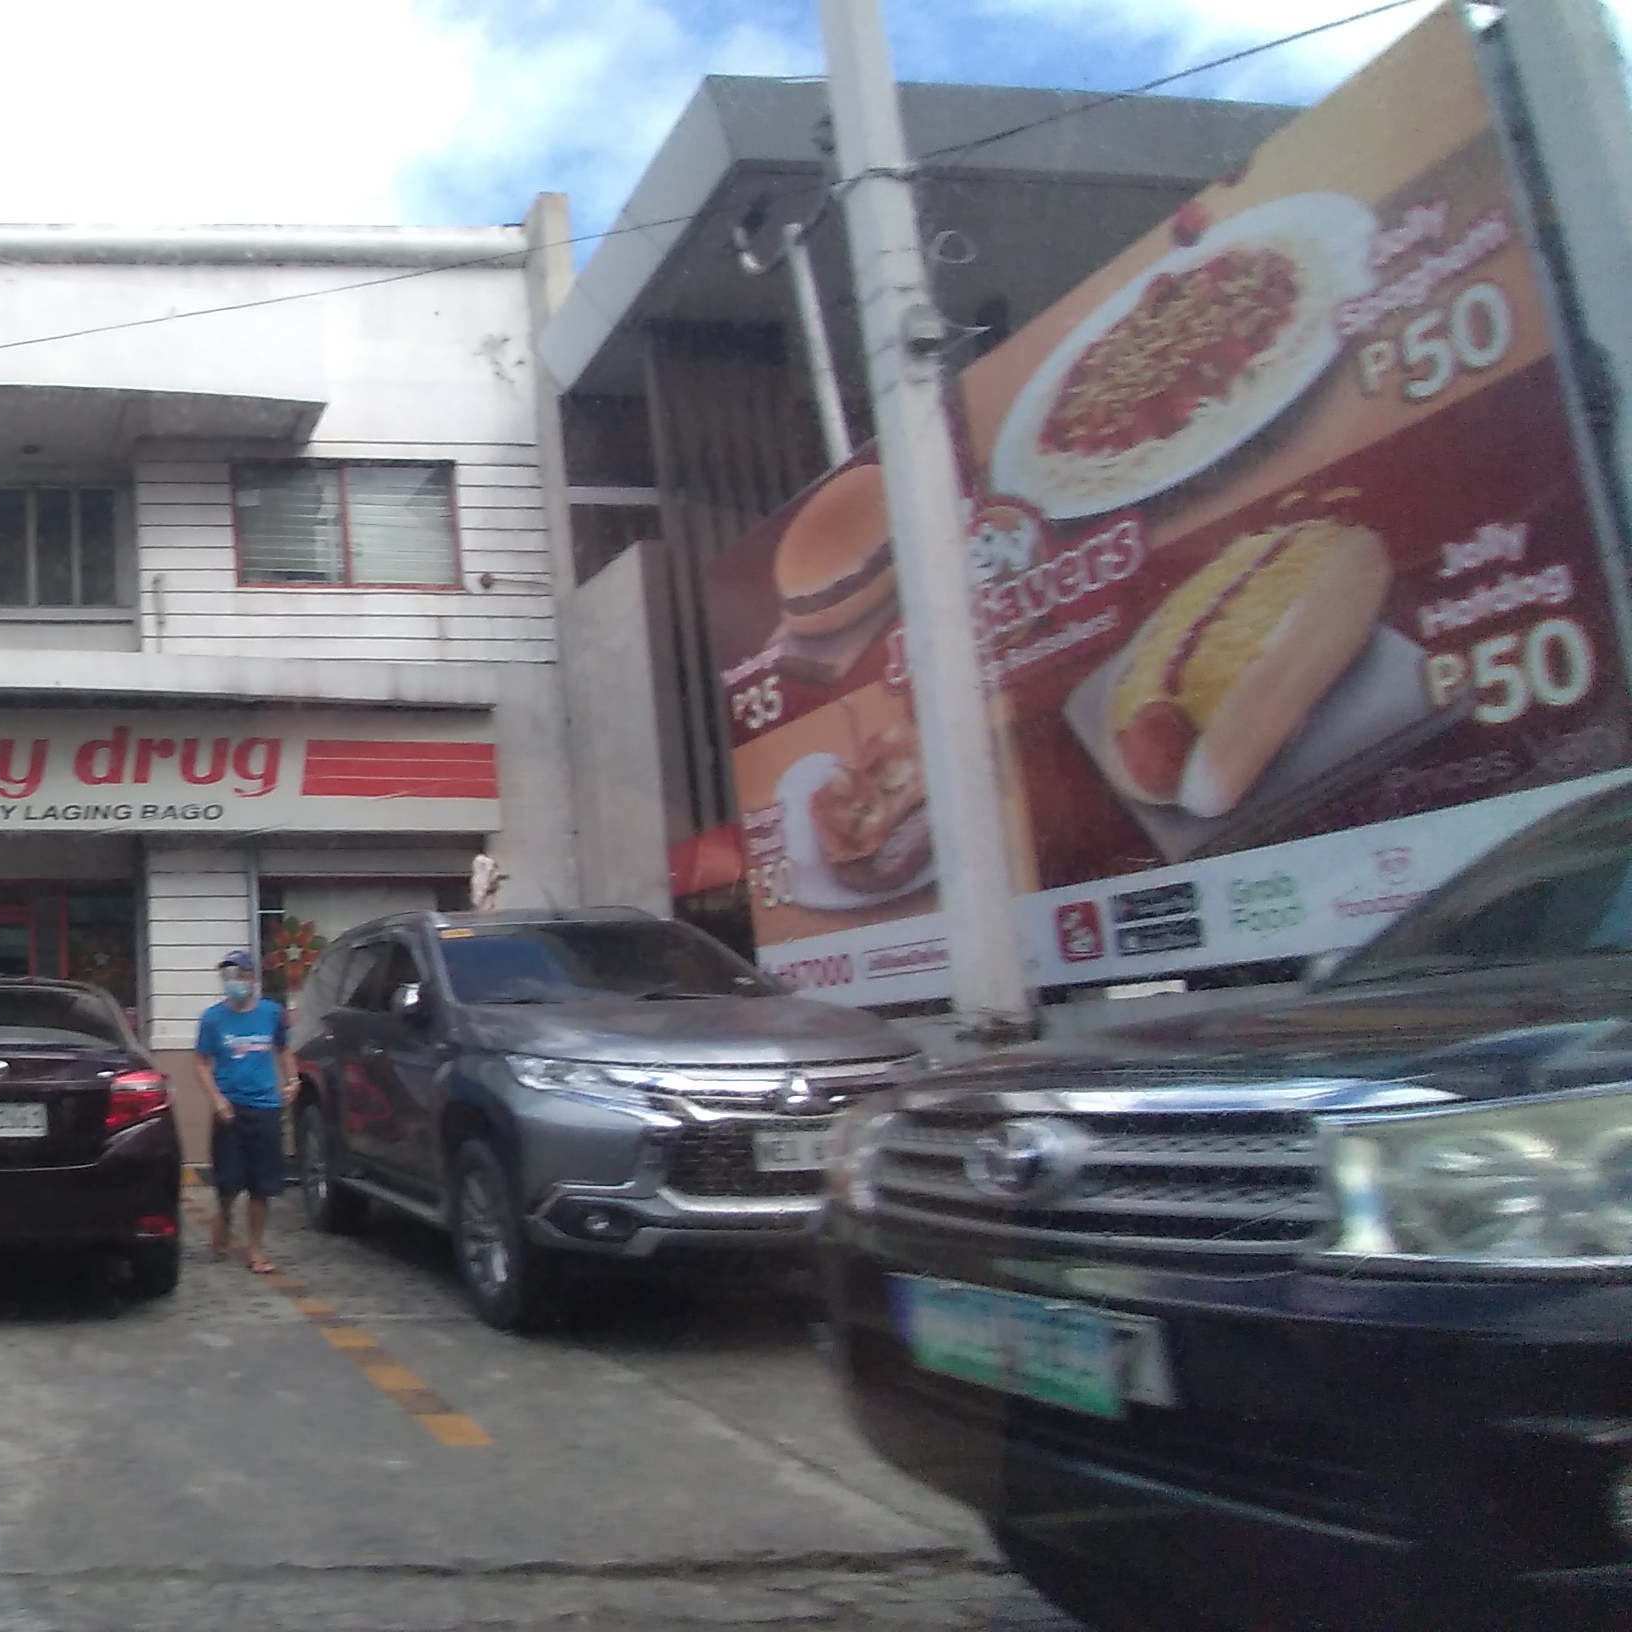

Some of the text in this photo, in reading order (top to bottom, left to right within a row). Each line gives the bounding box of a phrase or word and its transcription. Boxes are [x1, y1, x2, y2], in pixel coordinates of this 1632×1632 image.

[72, 725, 284, 798] drug
[24, 804, 134, 821] LAGING
[138, 804, 225, 821] BAGO
